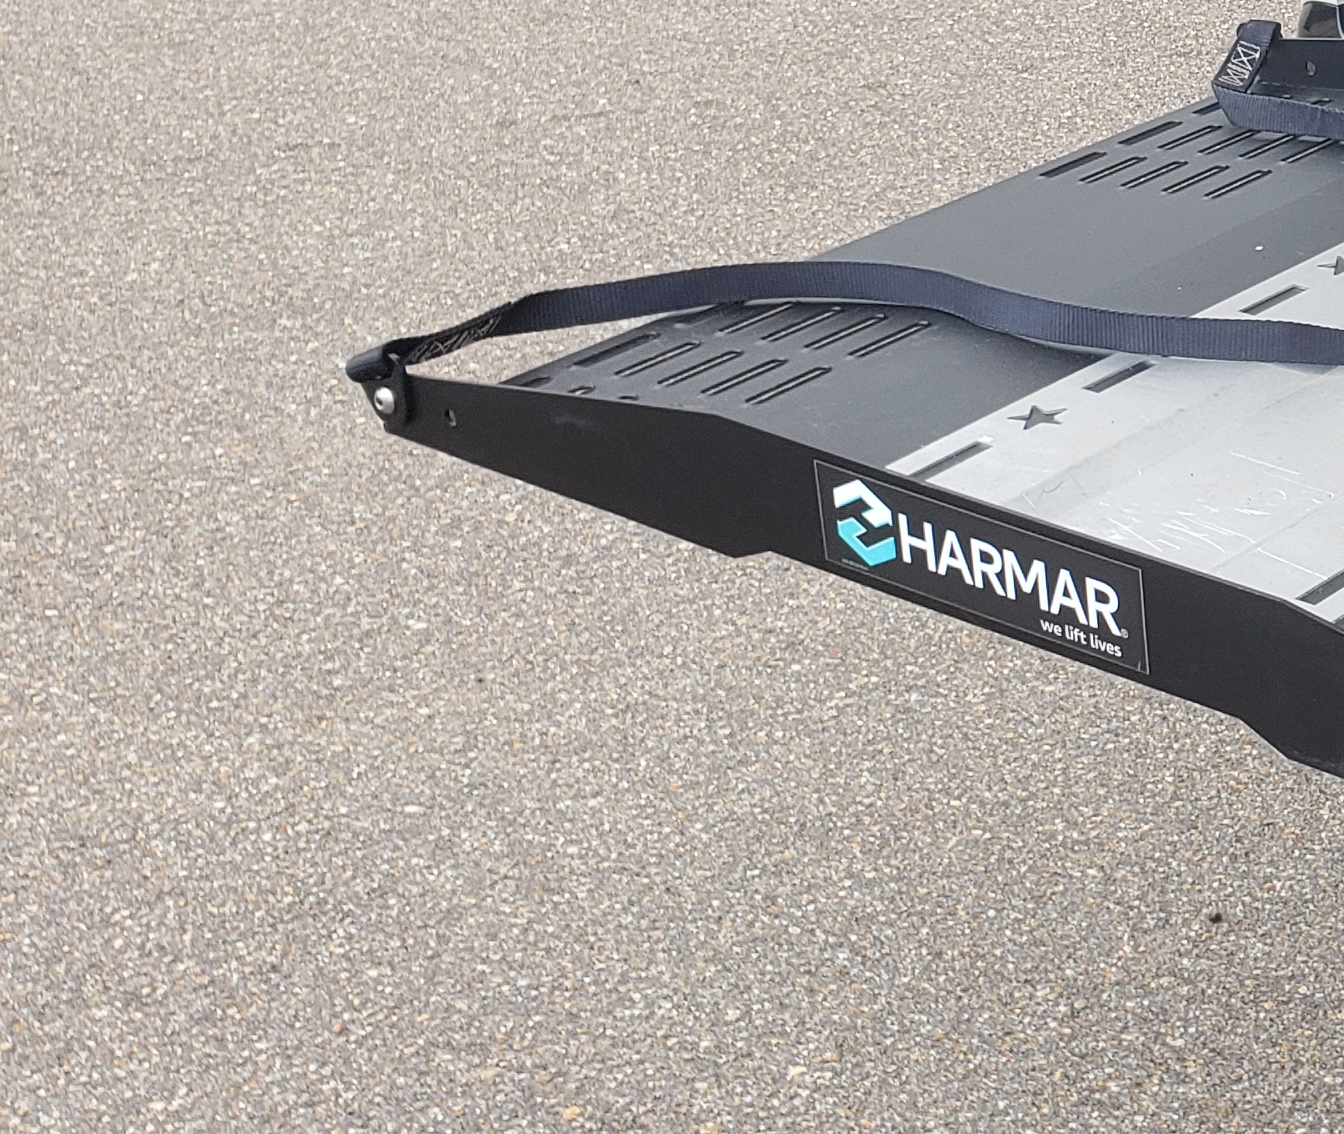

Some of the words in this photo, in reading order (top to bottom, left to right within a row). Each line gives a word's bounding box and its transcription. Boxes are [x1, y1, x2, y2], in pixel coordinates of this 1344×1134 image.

[898, 512, 1121, 637] HARMAR
[1040, 619, 1062, 637] we
[1064, 624, 1087, 645] lift
[1089, 633, 1122, 657] lives
